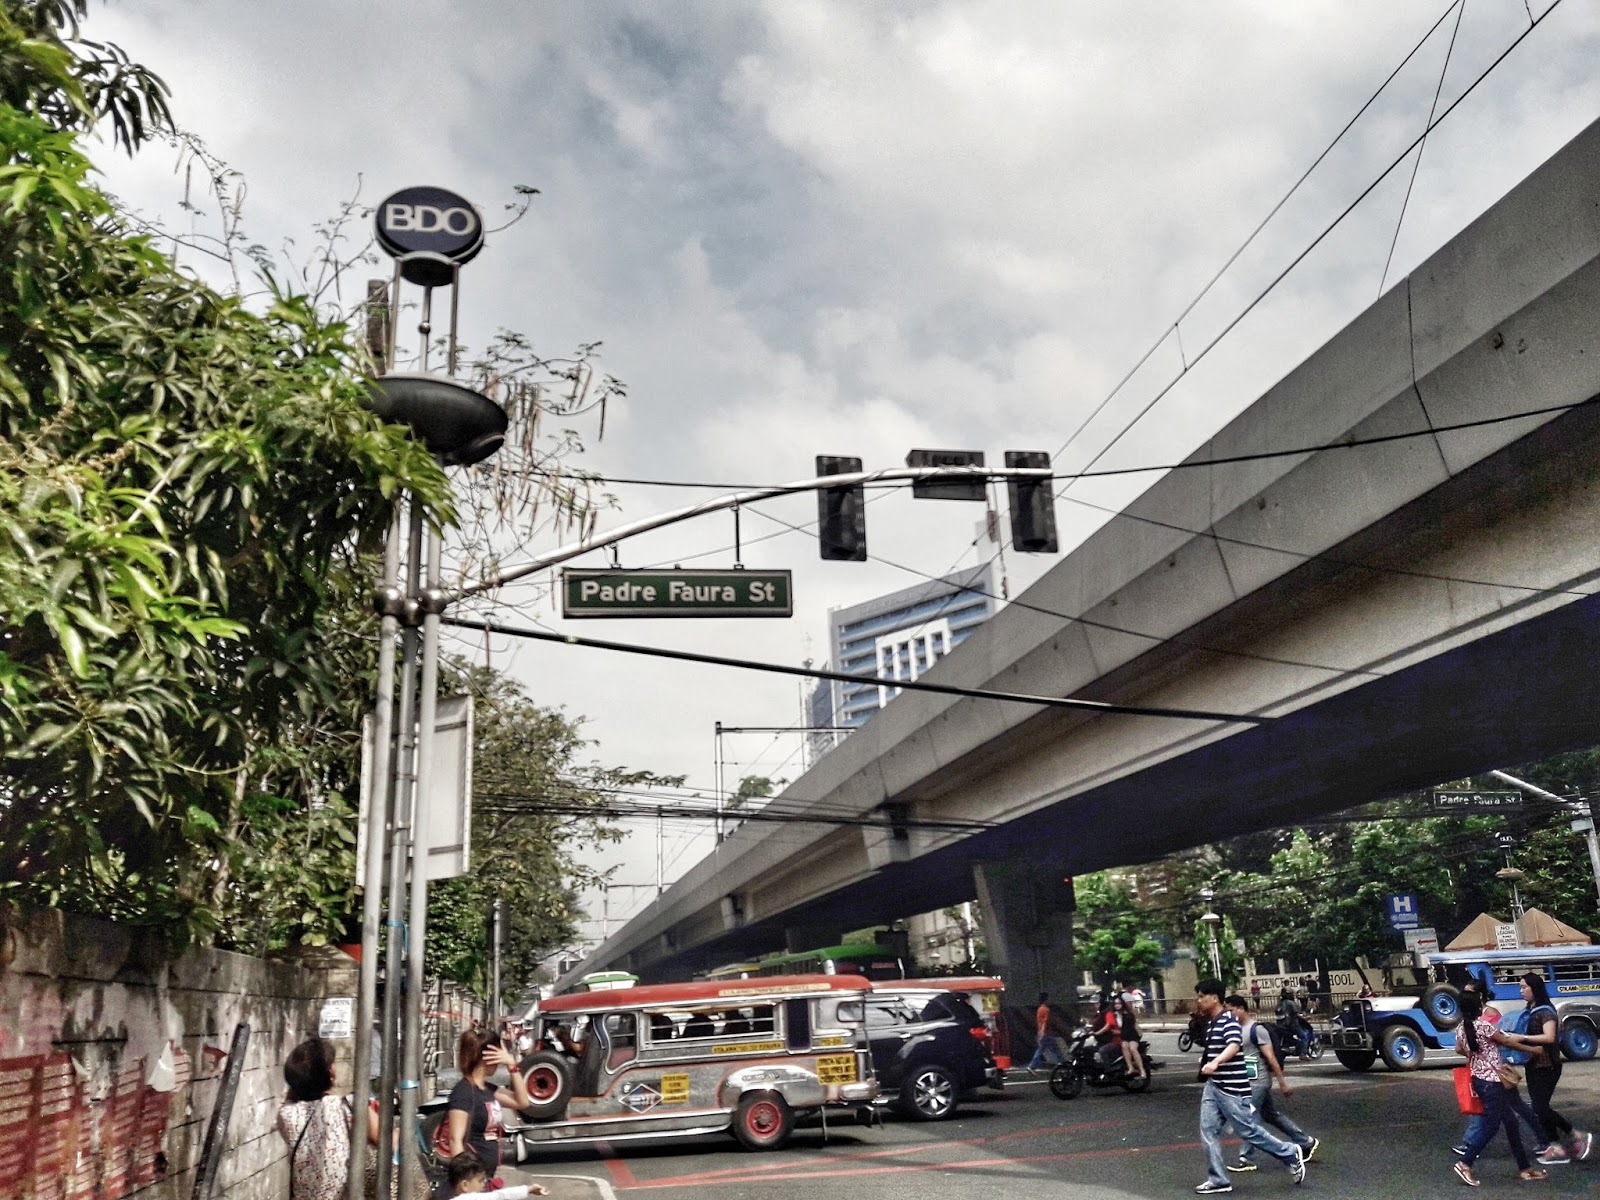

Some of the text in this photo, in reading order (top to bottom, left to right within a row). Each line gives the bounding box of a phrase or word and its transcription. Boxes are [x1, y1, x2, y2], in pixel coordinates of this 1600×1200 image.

[384, 203, 476, 237] BDO
[580, 580, 776, 602] Padre Faura St
[1439, 794, 1470, 805] Padre
[1393, 896, 1412, 913] H
[1255, 977, 1285, 989] CIENCE
